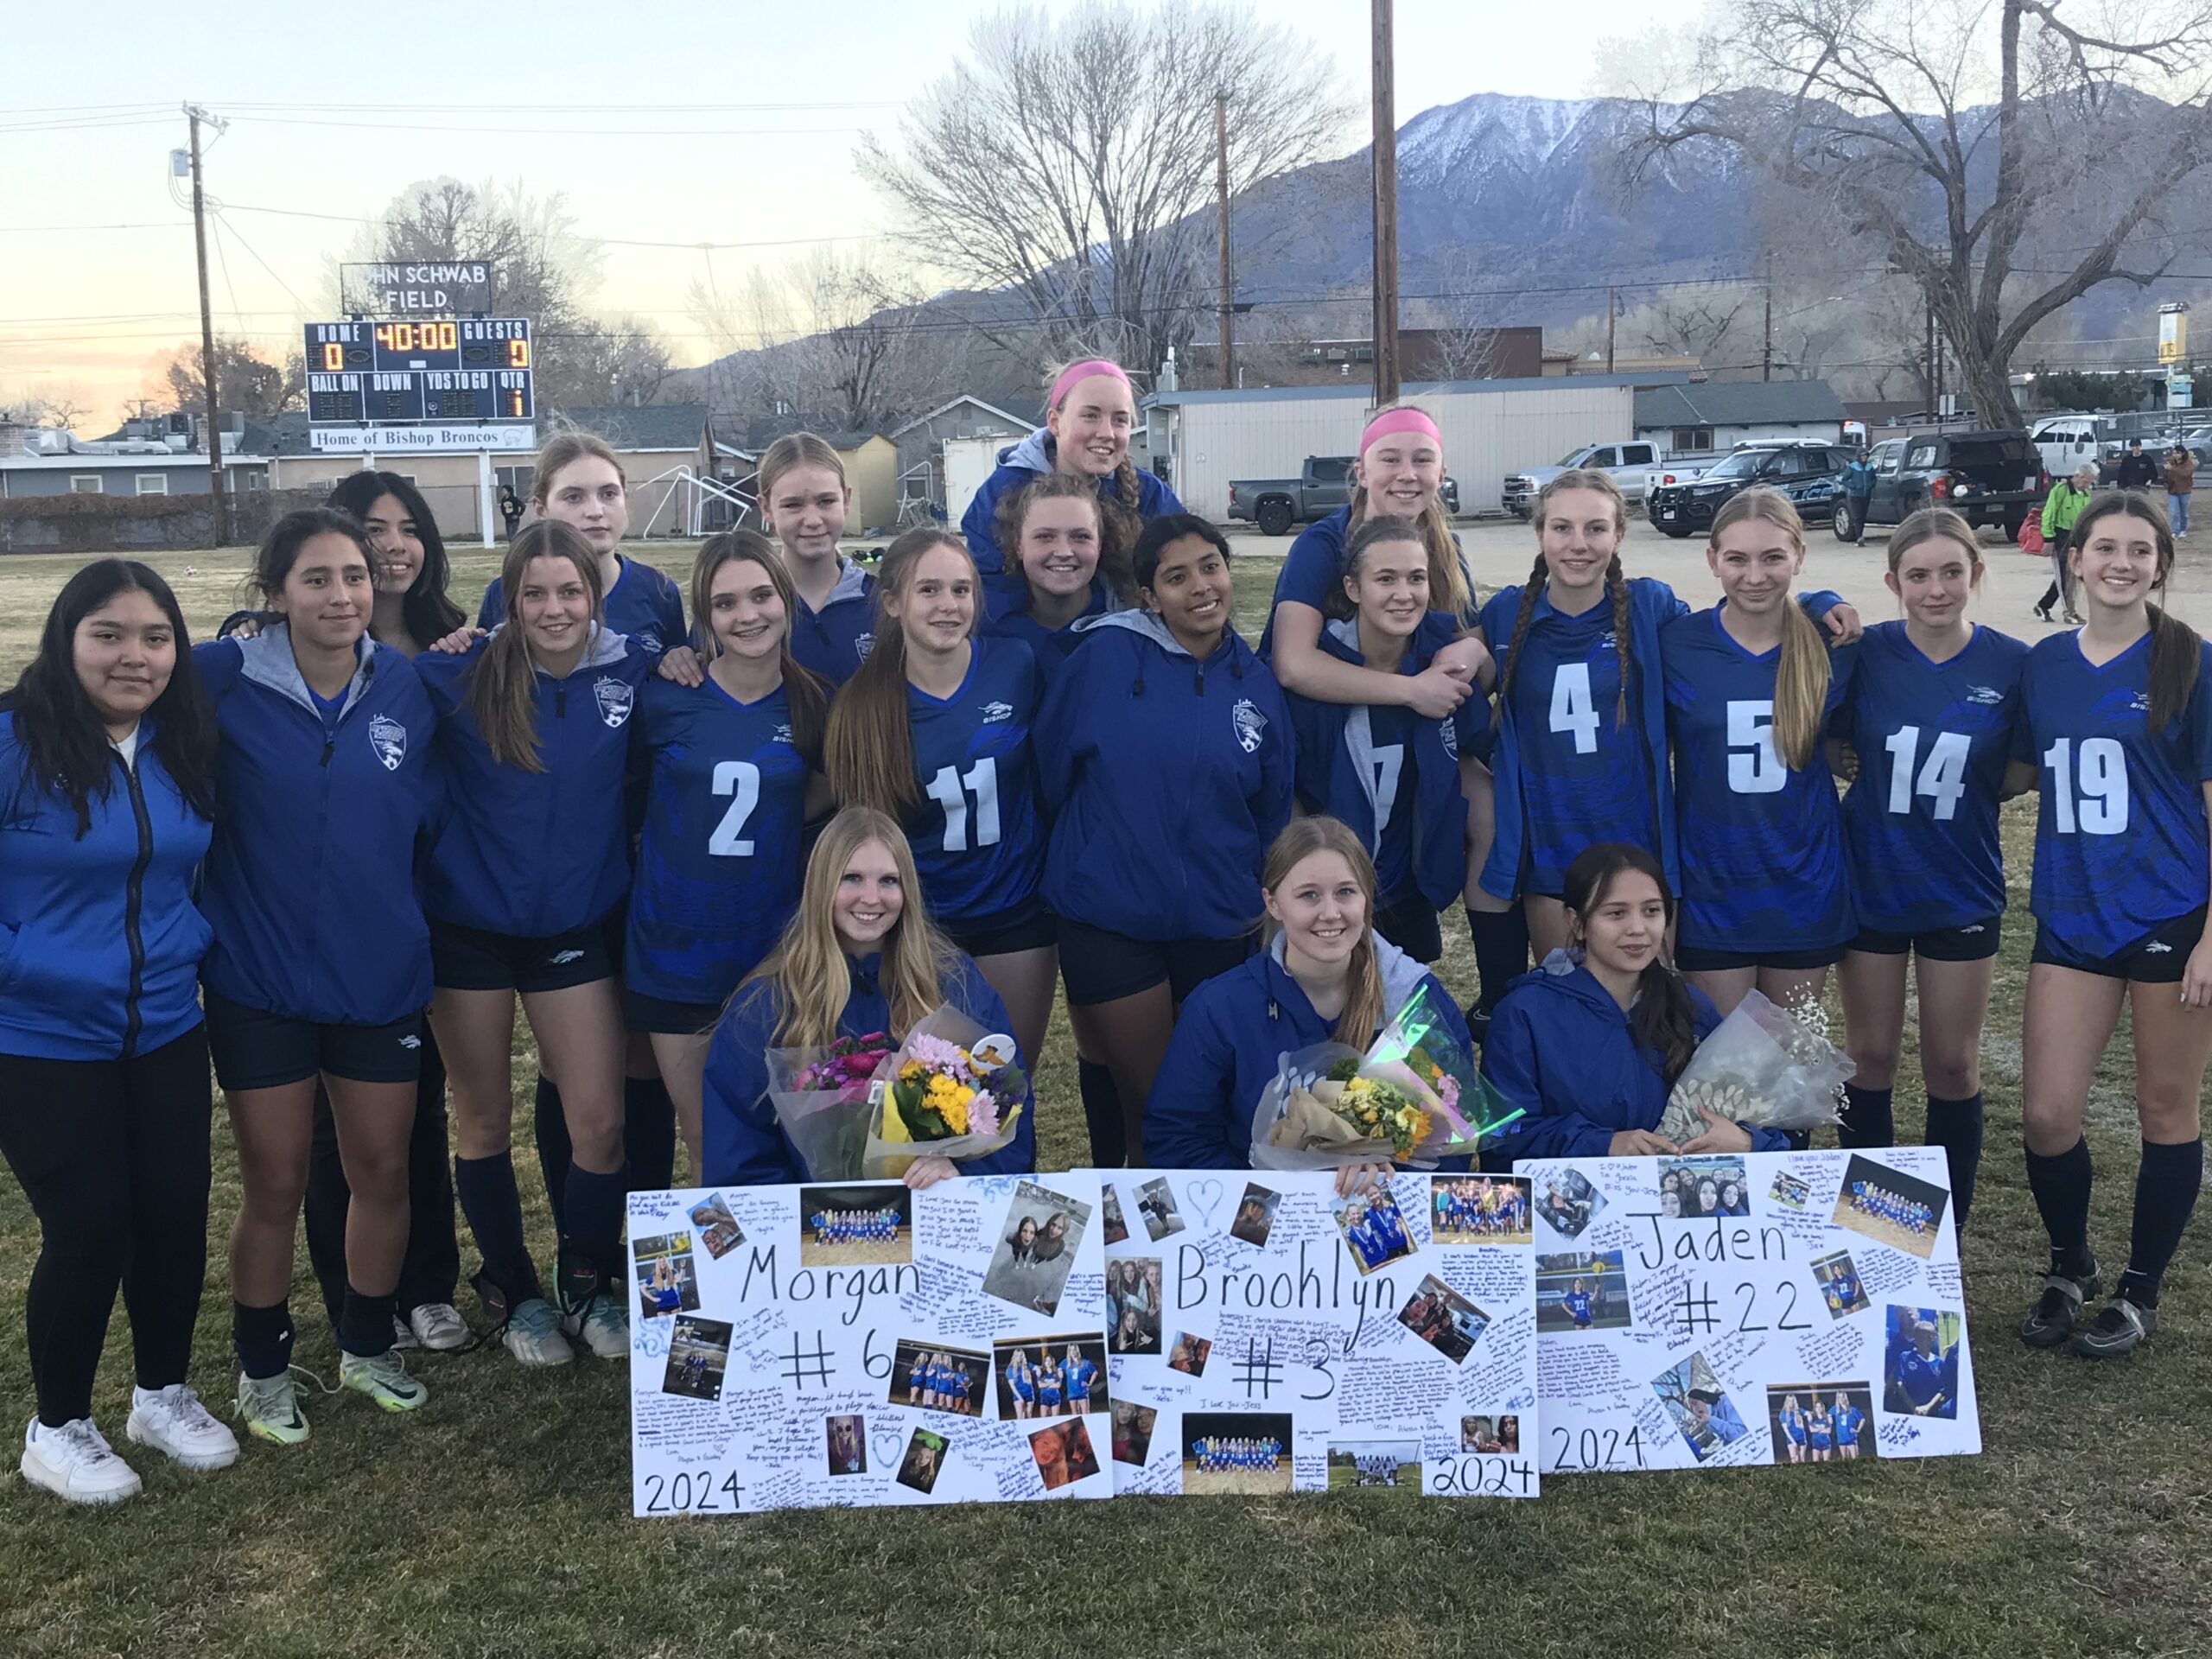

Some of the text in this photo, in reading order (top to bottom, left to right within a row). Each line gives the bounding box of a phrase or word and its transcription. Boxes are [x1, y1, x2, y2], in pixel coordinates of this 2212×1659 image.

[406, 265, 486, 283] SCHWAB
[387, 290, 447, 308] FIELD
[317, 324, 359, 342] HOME
[377, 324, 457, 351] 40:00
[464, 321, 523, 340] GUESTS
[311, 374, 359, 392] BALL ON
[373, 373, 411, 391] DOWN
[427, 372, 489, 390] YDS TO GO
[500, 372, 524, 389] QTR
[317, 429, 499, 446] Home of Bishop Broncos
[982, 711, 1013, 724] BISHOP
[1548, 662, 1599, 754] 4
[1727, 700, 1788, 794] 5
[1885, 725, 1973, 820] 14
[2044, 737, 2129, 835] 19
[709, 760, 760, 856] 2
[925, 757, 1001, 851] 11
[1625, 1212, 1786, 1270] Jaden
[741, 1245, 921, 1325] Morgan
[1551, 1426, 1649, 1469] 2024
[645, 1469, 746, 1512] 2024
[1433, 1456, 1535, 1495] 2024
